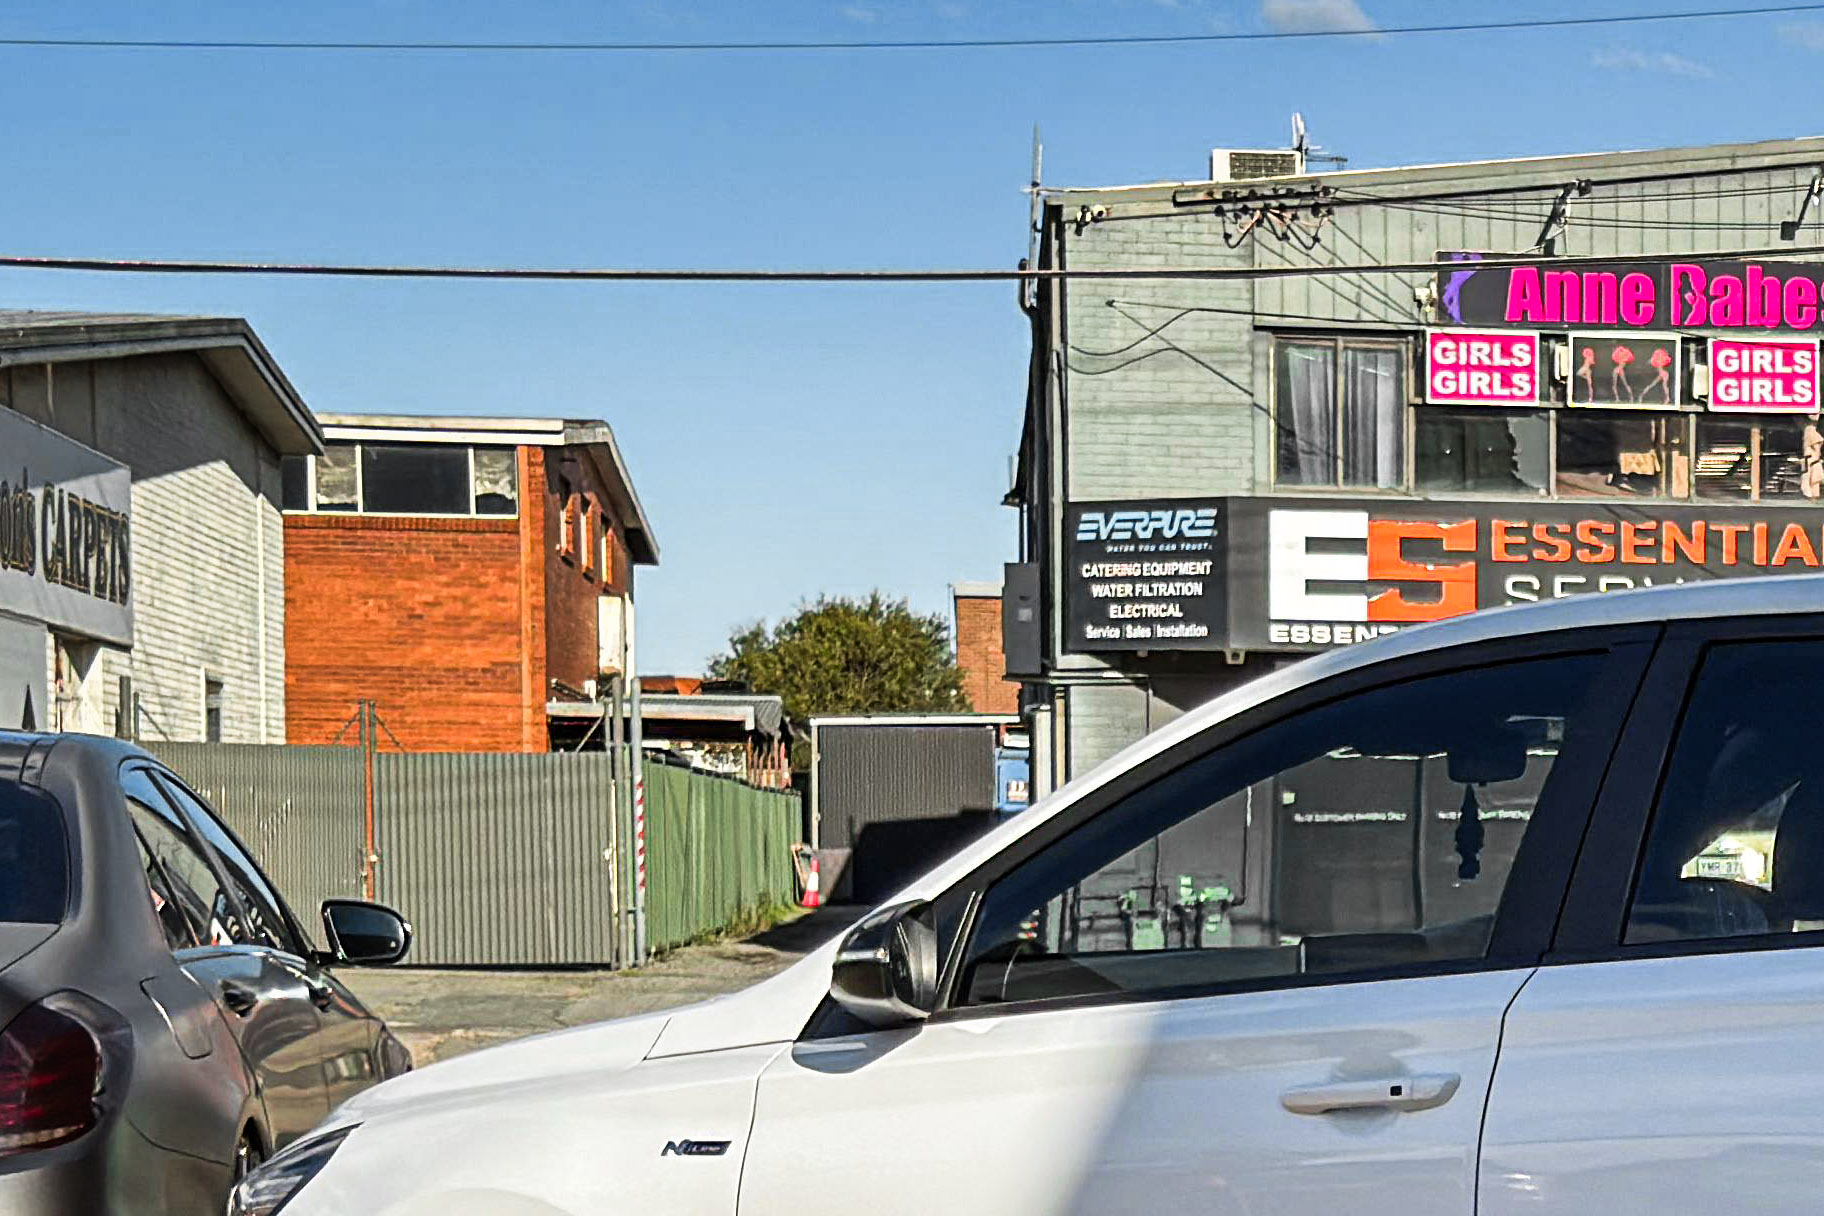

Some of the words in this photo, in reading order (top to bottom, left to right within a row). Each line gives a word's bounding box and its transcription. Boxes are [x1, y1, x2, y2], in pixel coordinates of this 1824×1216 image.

[1504, 266, 1655, 326] Anne
[1433, 341, 1532, 367] GIRLS
[1717, 348, 1812, 374] GIRLS
[1433, 371, 1532, 397] GIRLS
[1717, 378, 1812, 404] GIRLS
[1077, 508, 1218, 541] EVERPURE
[42, 481, 131, 606] CARPETS
[1082, 563, 1142, 578] CATERING
[1143, 561, 1212, 576] EQUIPMENT
[1092, 583, 1133, 598] WATER
[1135, 582, 1203, 597] FILTRATION
[1109, 603, 1183, 618] ELECTRICAL
[1086, 624, 1121, 639] Service
[1125, 624, 1152, 638] Sales
[1157, 624, 1208, 638] Installation
